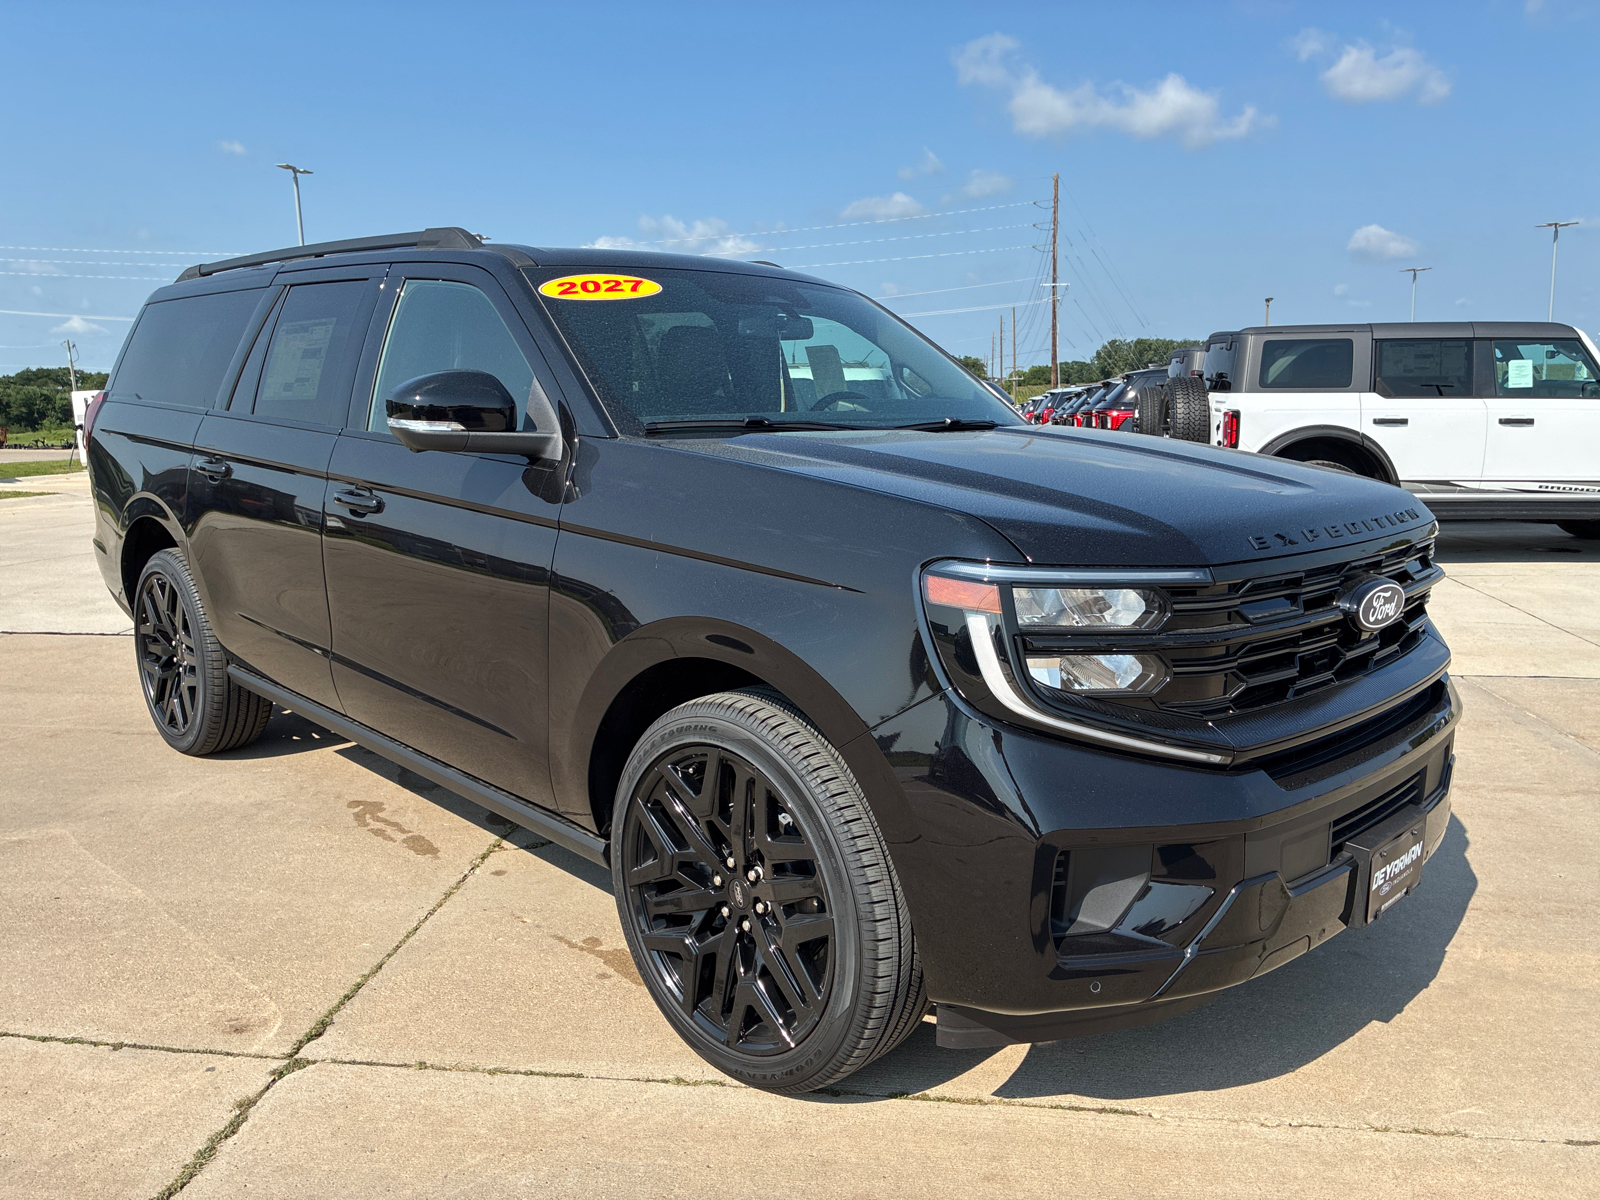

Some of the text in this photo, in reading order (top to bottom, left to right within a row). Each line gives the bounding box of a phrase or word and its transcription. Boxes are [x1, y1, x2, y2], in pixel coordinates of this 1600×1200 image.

[556, 279, 645, 296] 2027
[1538, 485, 1600, 493] BRONC
[1247, 508, 1420, 551] EXPEDITION
[1368, 590, 1399, 623] Ford
[659, 723, 718, 742] TOURING
[1371, 840, 1424, 891] DEYARMAN
